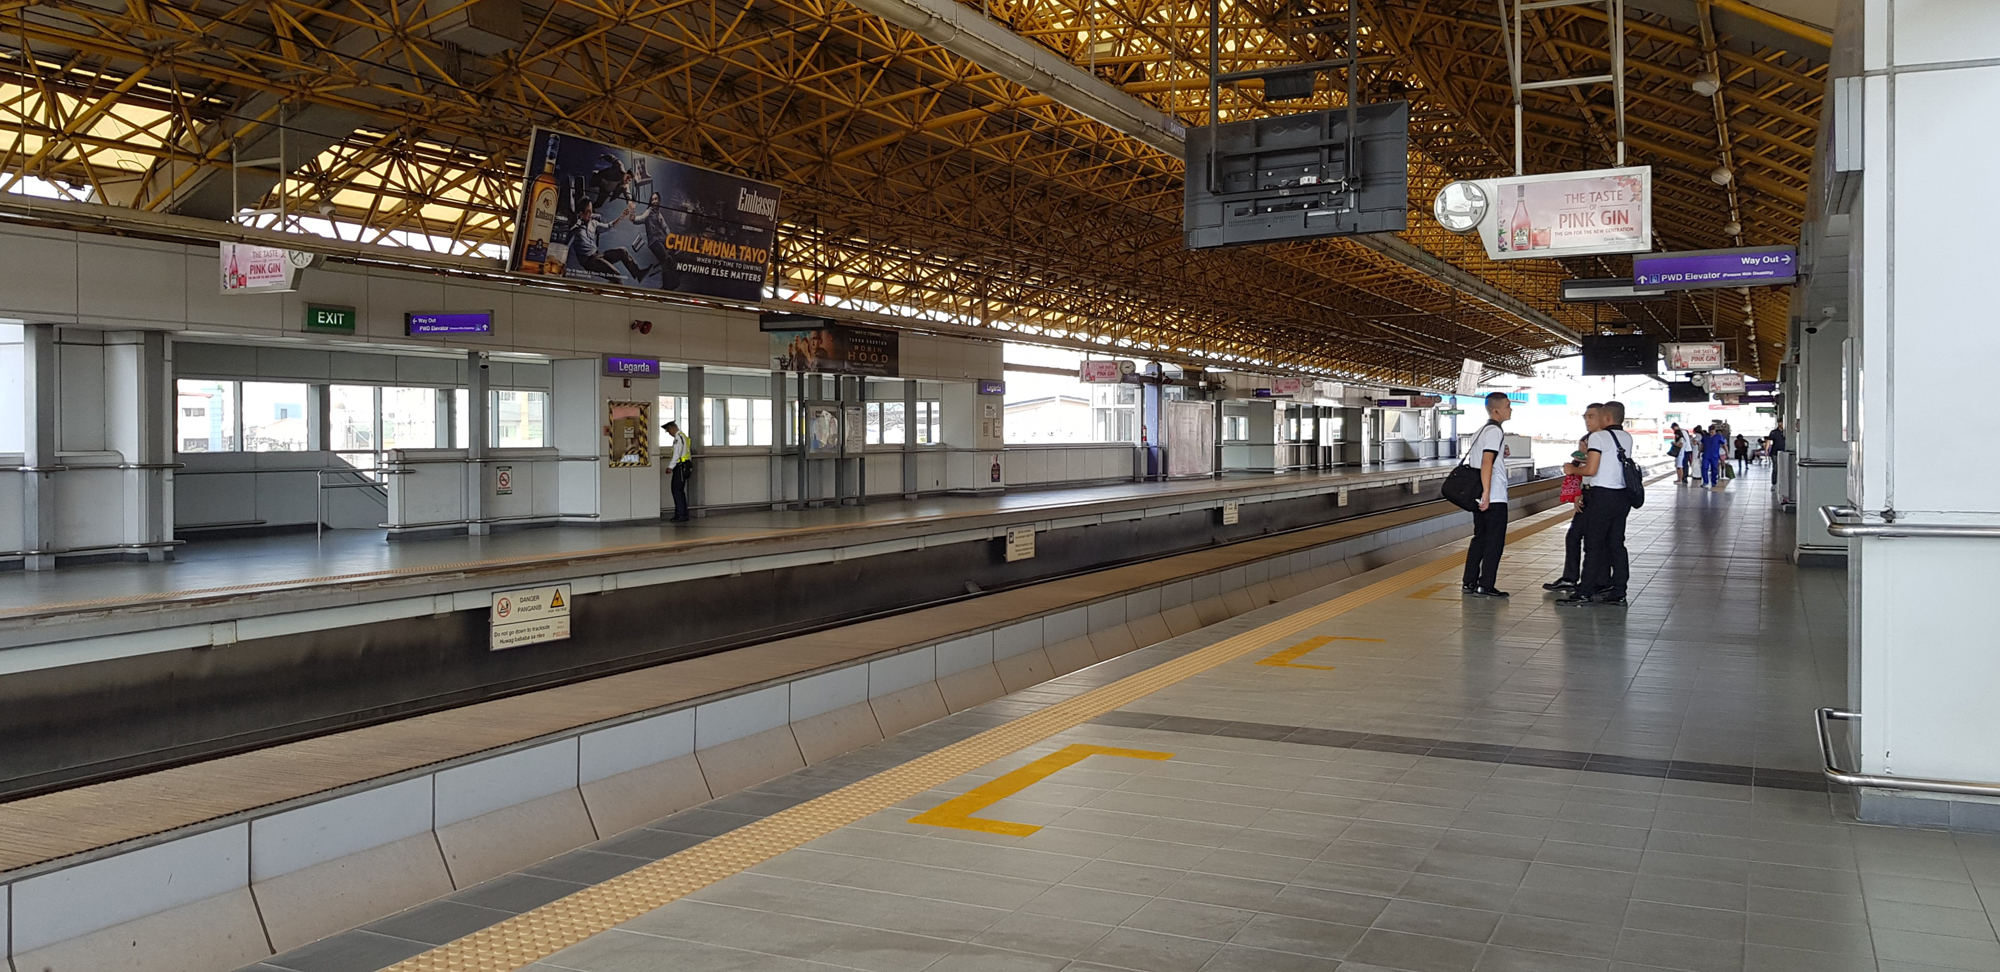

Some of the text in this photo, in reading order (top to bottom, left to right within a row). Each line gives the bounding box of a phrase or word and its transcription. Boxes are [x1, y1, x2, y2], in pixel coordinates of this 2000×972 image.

[1564, 190, 1623, 204] THE TASTE
[737, 187, 776, 221] Embassy
[1559, 209, 1629, 229] PINK GIN
[252, 250, 278, 259] THE TASTE
[665, 233, 767, 264] CHILL MUNA TAYO
[696, 256, 711, 264] WHEN
[712, 258, 722, 266] IT'S
[722, 260, 734, 268] TIME
[1741, 255, 1779, 266] Way Out
[249, 263, 281, 275] PINK GIN
[676, 262, 762, 282] NOTHING ELSE MATTERS
[1661, 273, 1683, 282] PWD
[1685, 272, 1721, 281] Elevator
[317, 311, 344, 325] EXIT
[854, 344, 883, 353] ROBIN
[847, 351, 889, 363] HOOD
[619, 360, 650, 374] Legarda
[519, 594, 540, 603] DANGER
[517, 604, 542, 613] PANGANIB
